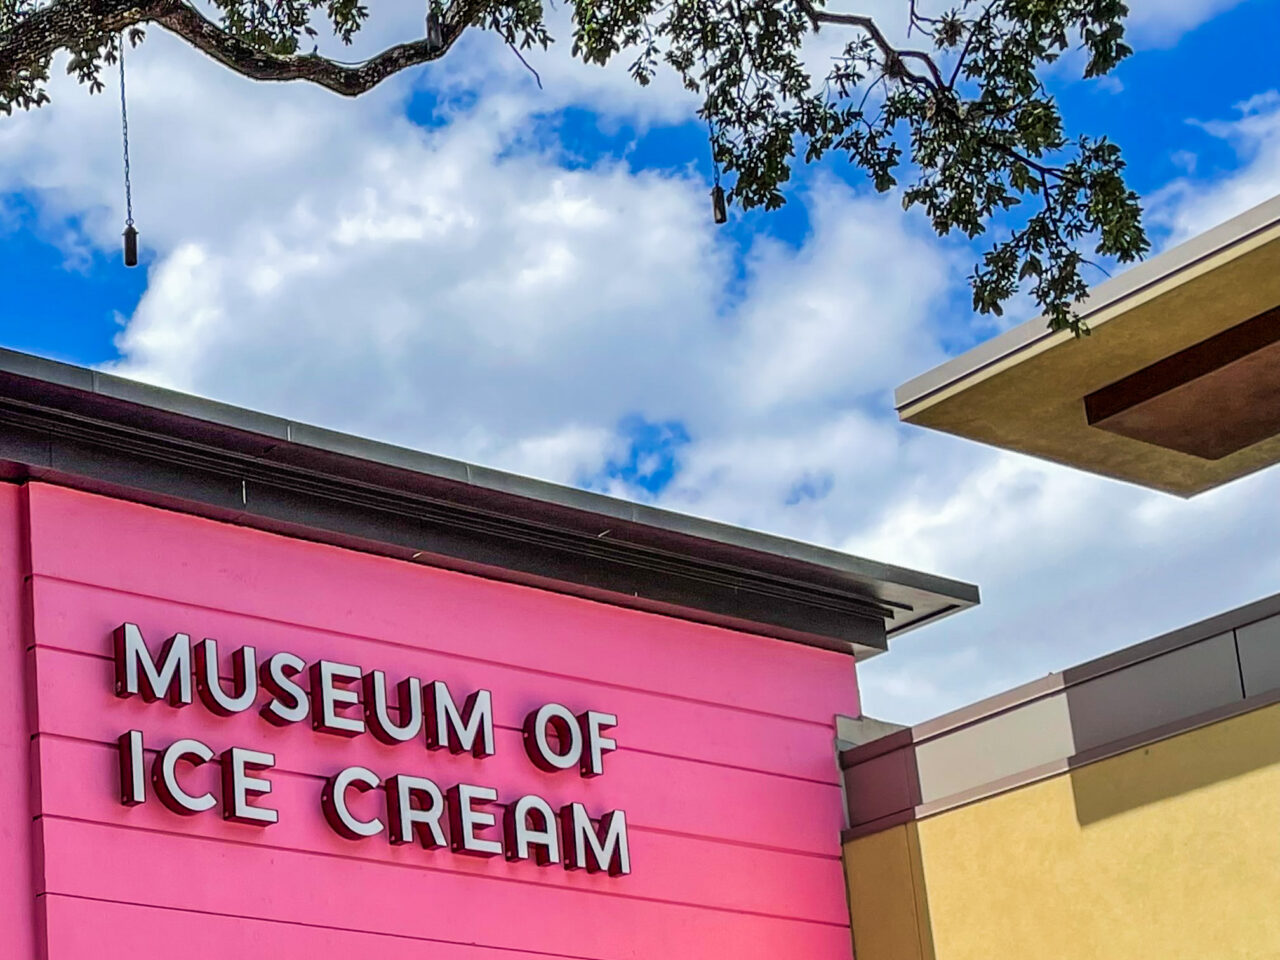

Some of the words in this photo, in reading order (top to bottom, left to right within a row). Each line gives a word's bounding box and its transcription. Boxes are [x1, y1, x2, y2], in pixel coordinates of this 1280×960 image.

[113, 622, 496, 760] MUSEUM
[523, 703, 618, 778] OF
[119, 729, 279, 827] ICE
[322, 766, 632, 878] CREAM
